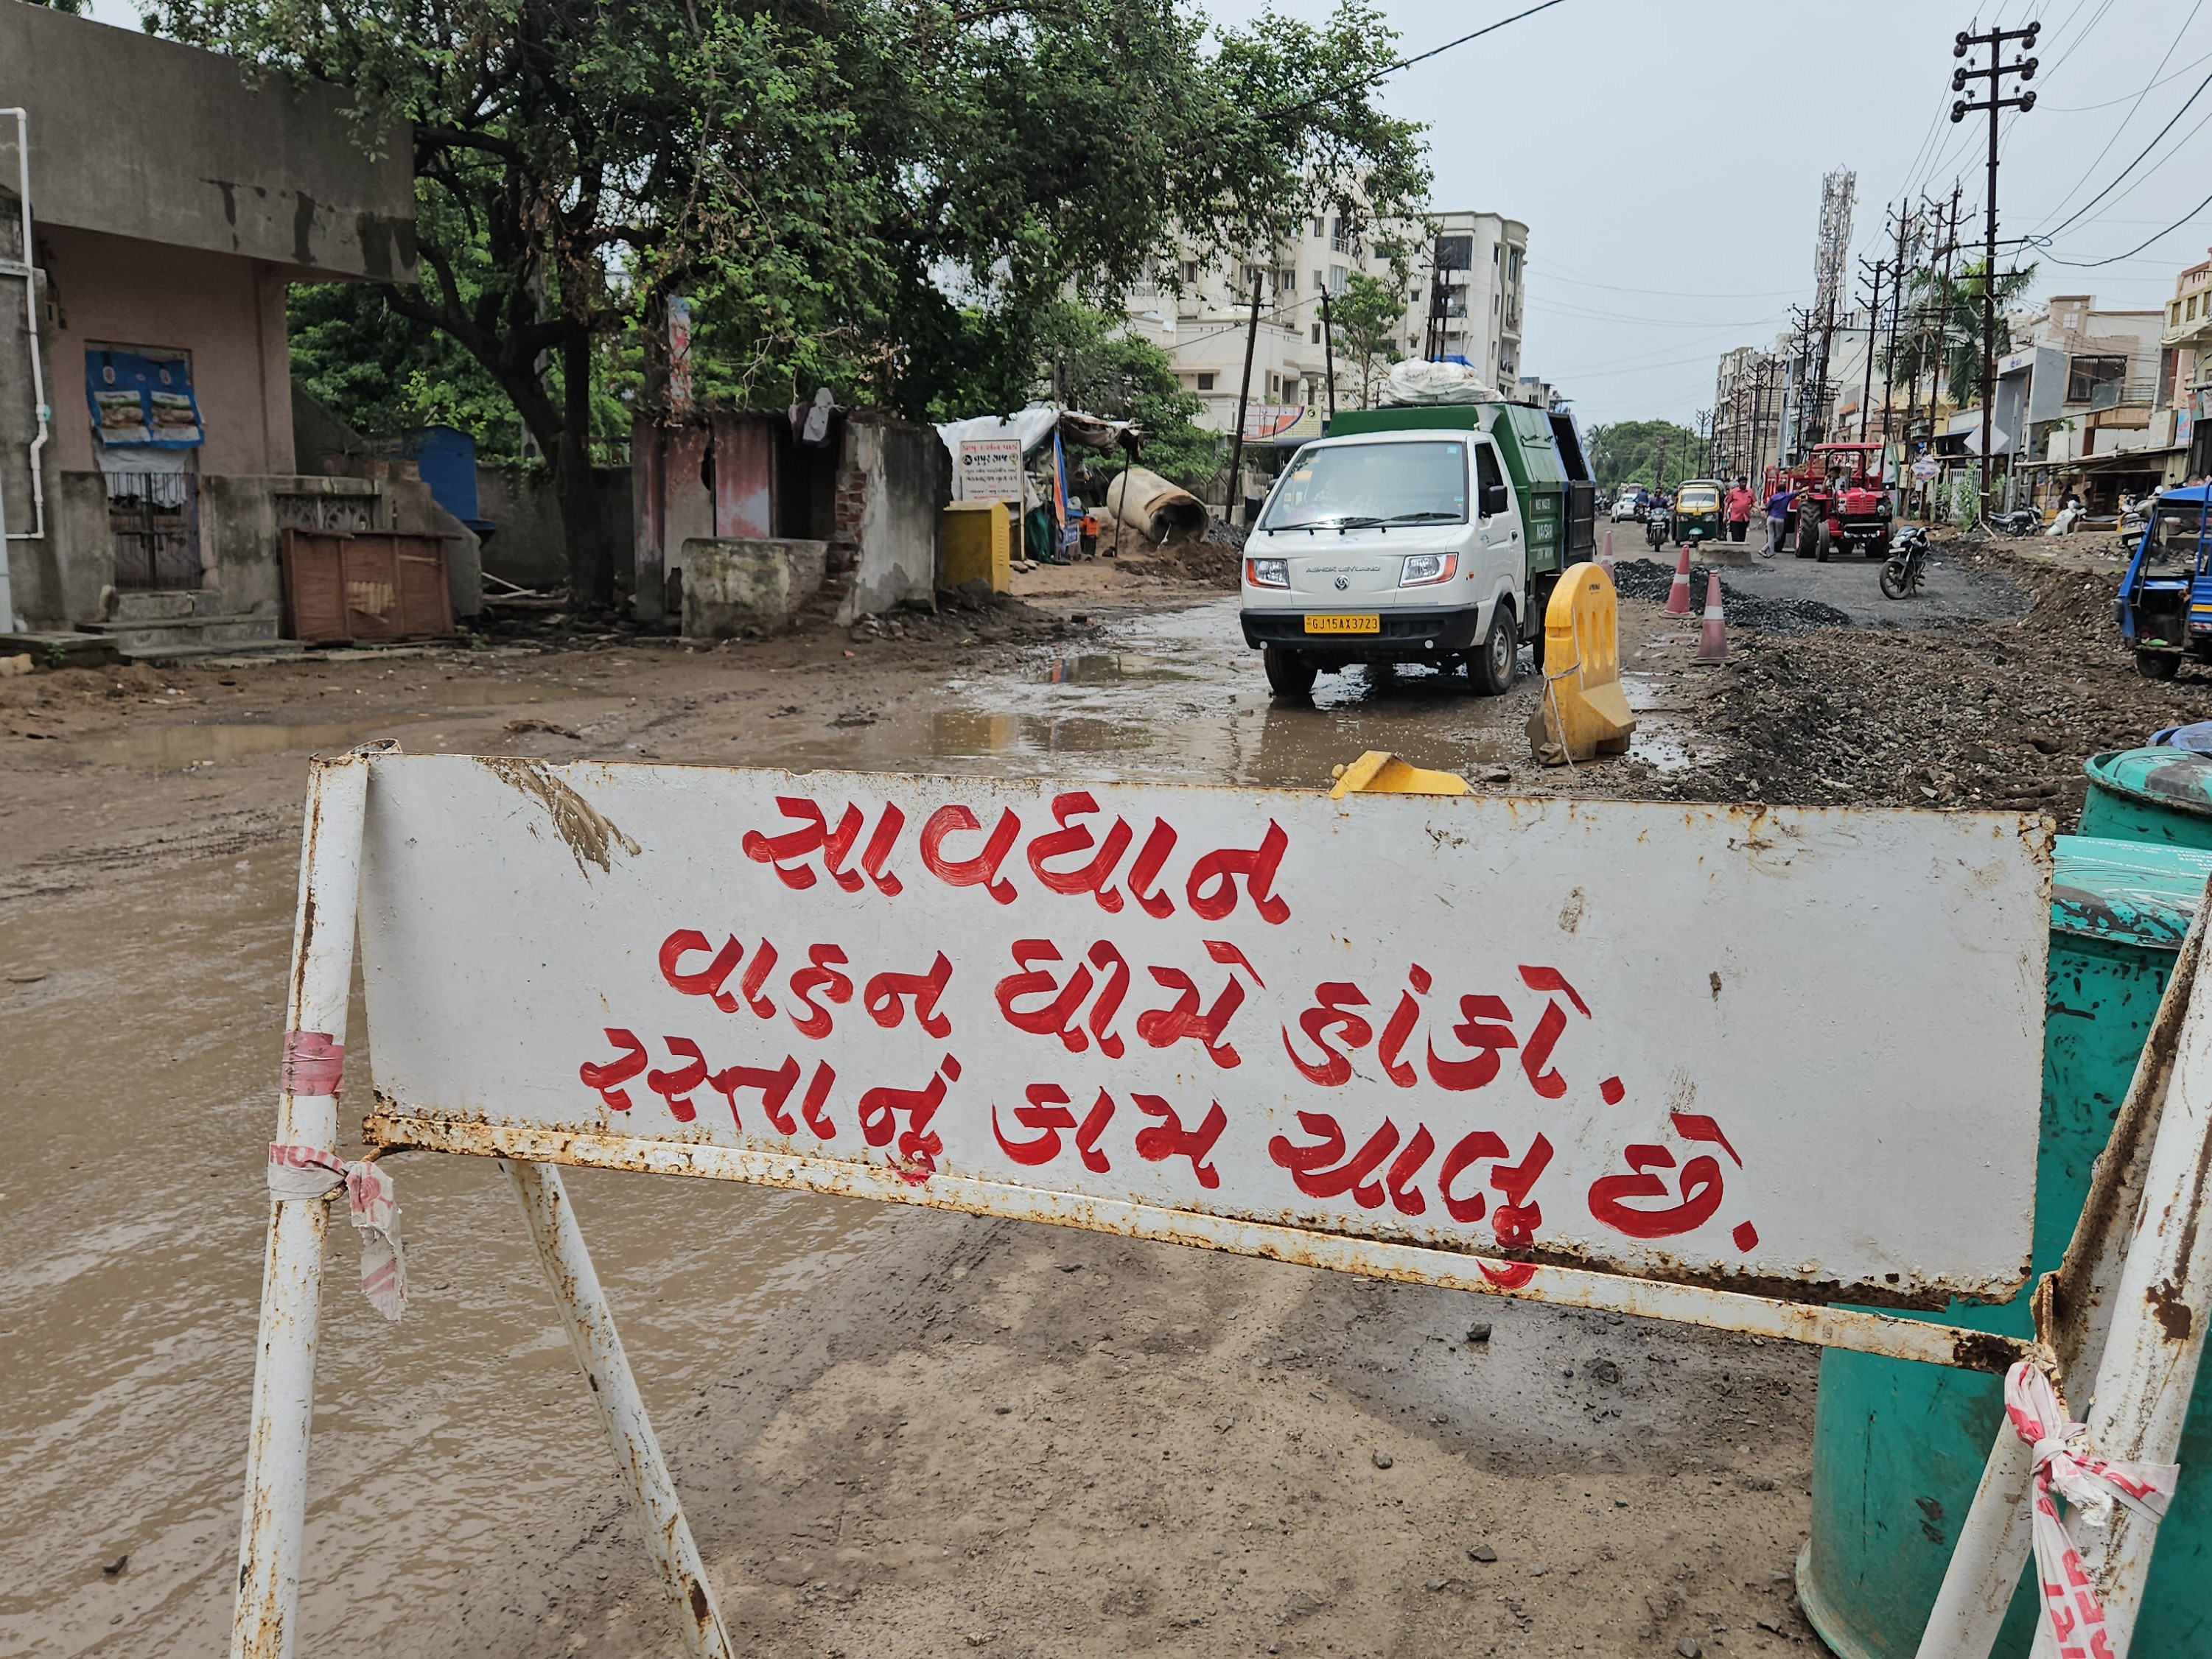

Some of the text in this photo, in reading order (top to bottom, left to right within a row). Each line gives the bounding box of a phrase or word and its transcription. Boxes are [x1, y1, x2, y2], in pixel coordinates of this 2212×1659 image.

[1312, 618, 1378, 630] GJ15AX3723
[1338, 564, 1381, 572] LEYLAND
[743, 792, 1290, 925] સાવધાન
[659, 930, 952, 1039] વાહન
[995, 939, 1264, 1068] ધીમે
[993, 1084, 1227, 1188] કામ
[1269, 1111, 1553, 1290] ચાલુ
